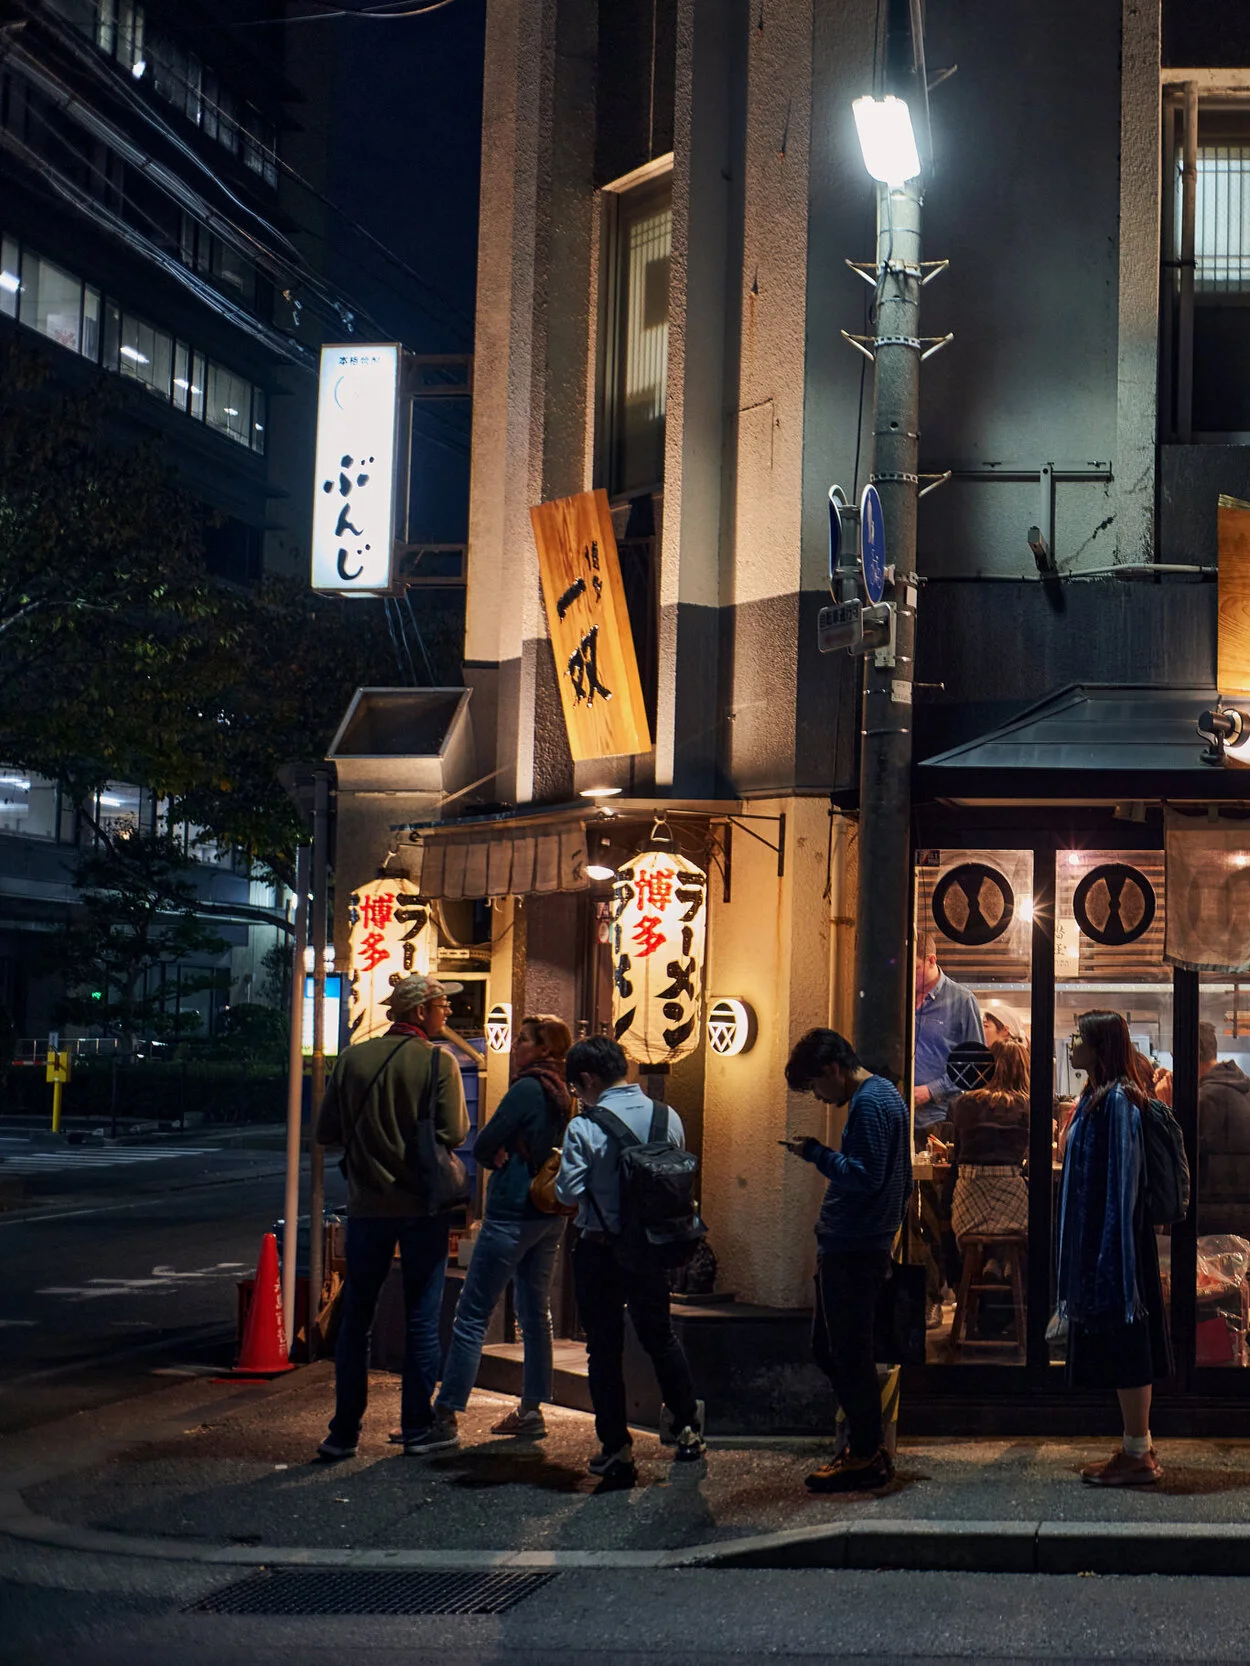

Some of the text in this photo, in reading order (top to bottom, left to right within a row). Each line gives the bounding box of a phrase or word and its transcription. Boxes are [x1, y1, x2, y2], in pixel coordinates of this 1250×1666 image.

[323, 454, 375, 581] ぶんじ
[357, 892, 396, 972] 博多
[634, 868, 677, 958] 博多
[654, 870, 708, 1050] ラーメン
